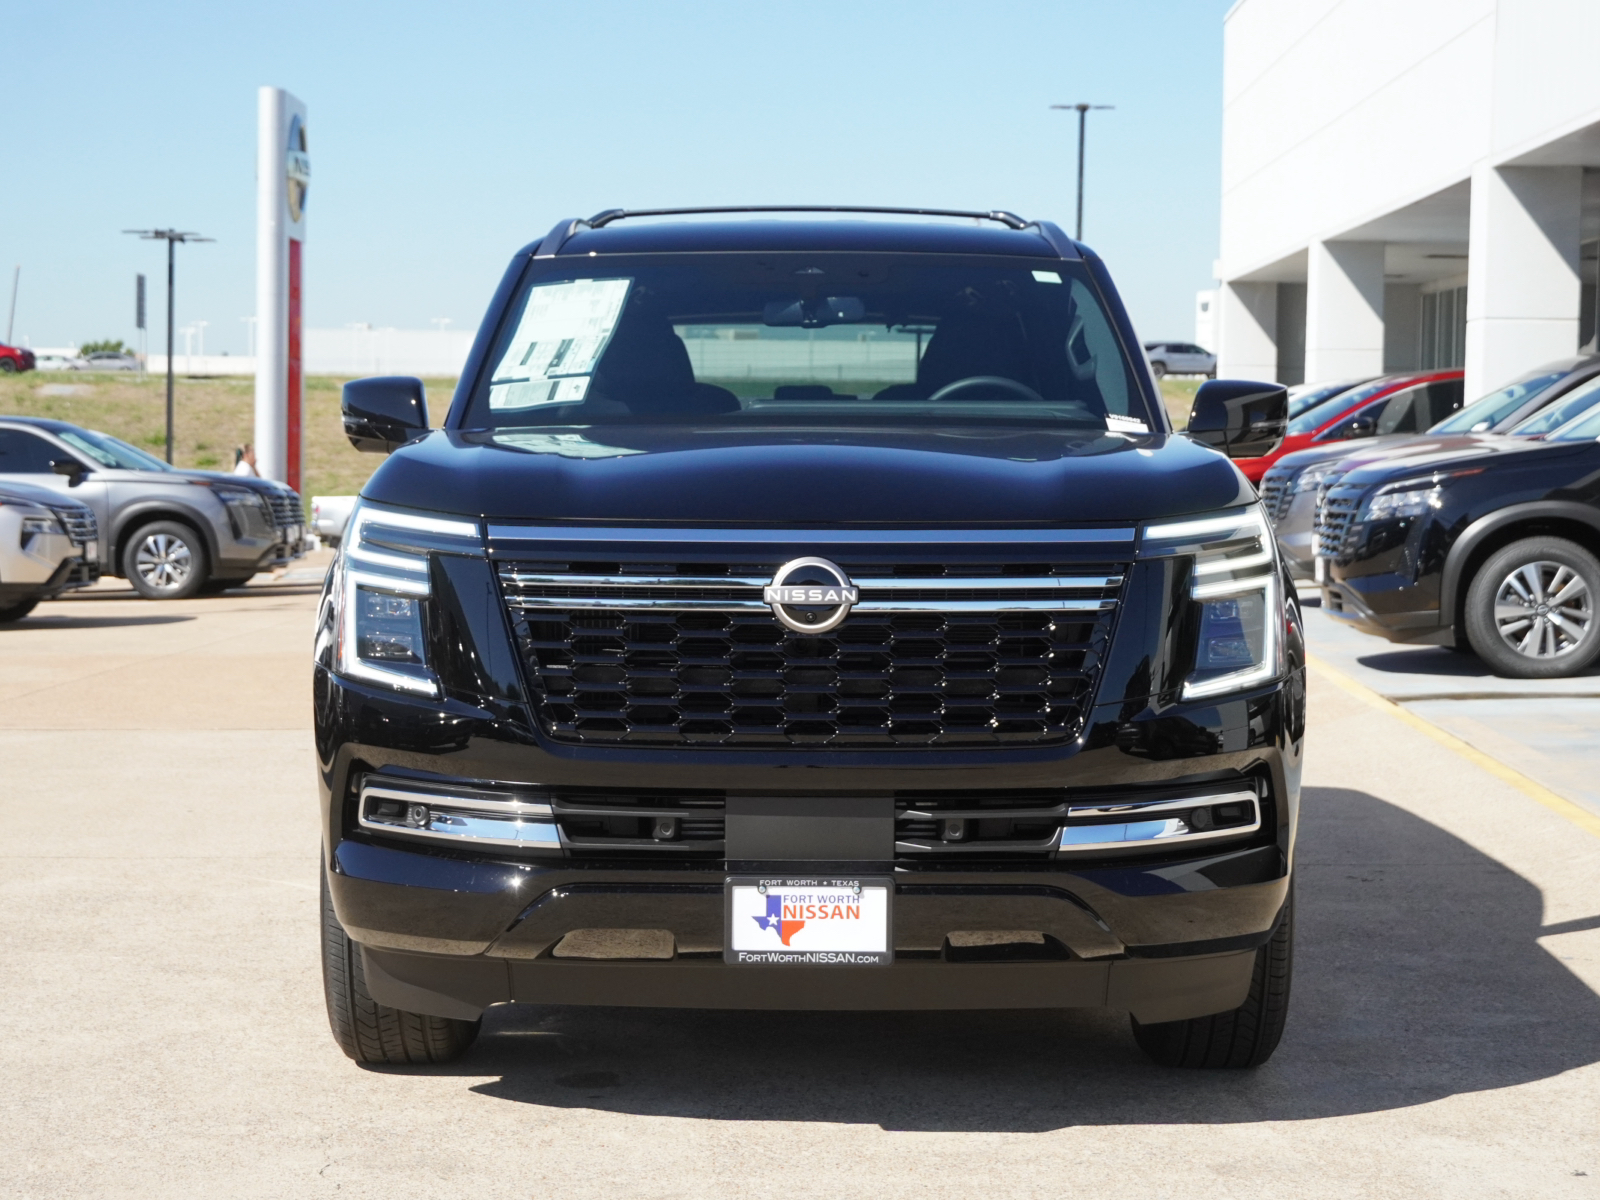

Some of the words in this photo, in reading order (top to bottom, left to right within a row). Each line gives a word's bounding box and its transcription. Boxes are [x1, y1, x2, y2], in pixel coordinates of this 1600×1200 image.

[766, 589, 856, 602] NISSAN
[783, 894, 814, 904] FORT
[817, 894, 860, 904] WORTH
[783, 905, 860, 920] NISSAN
